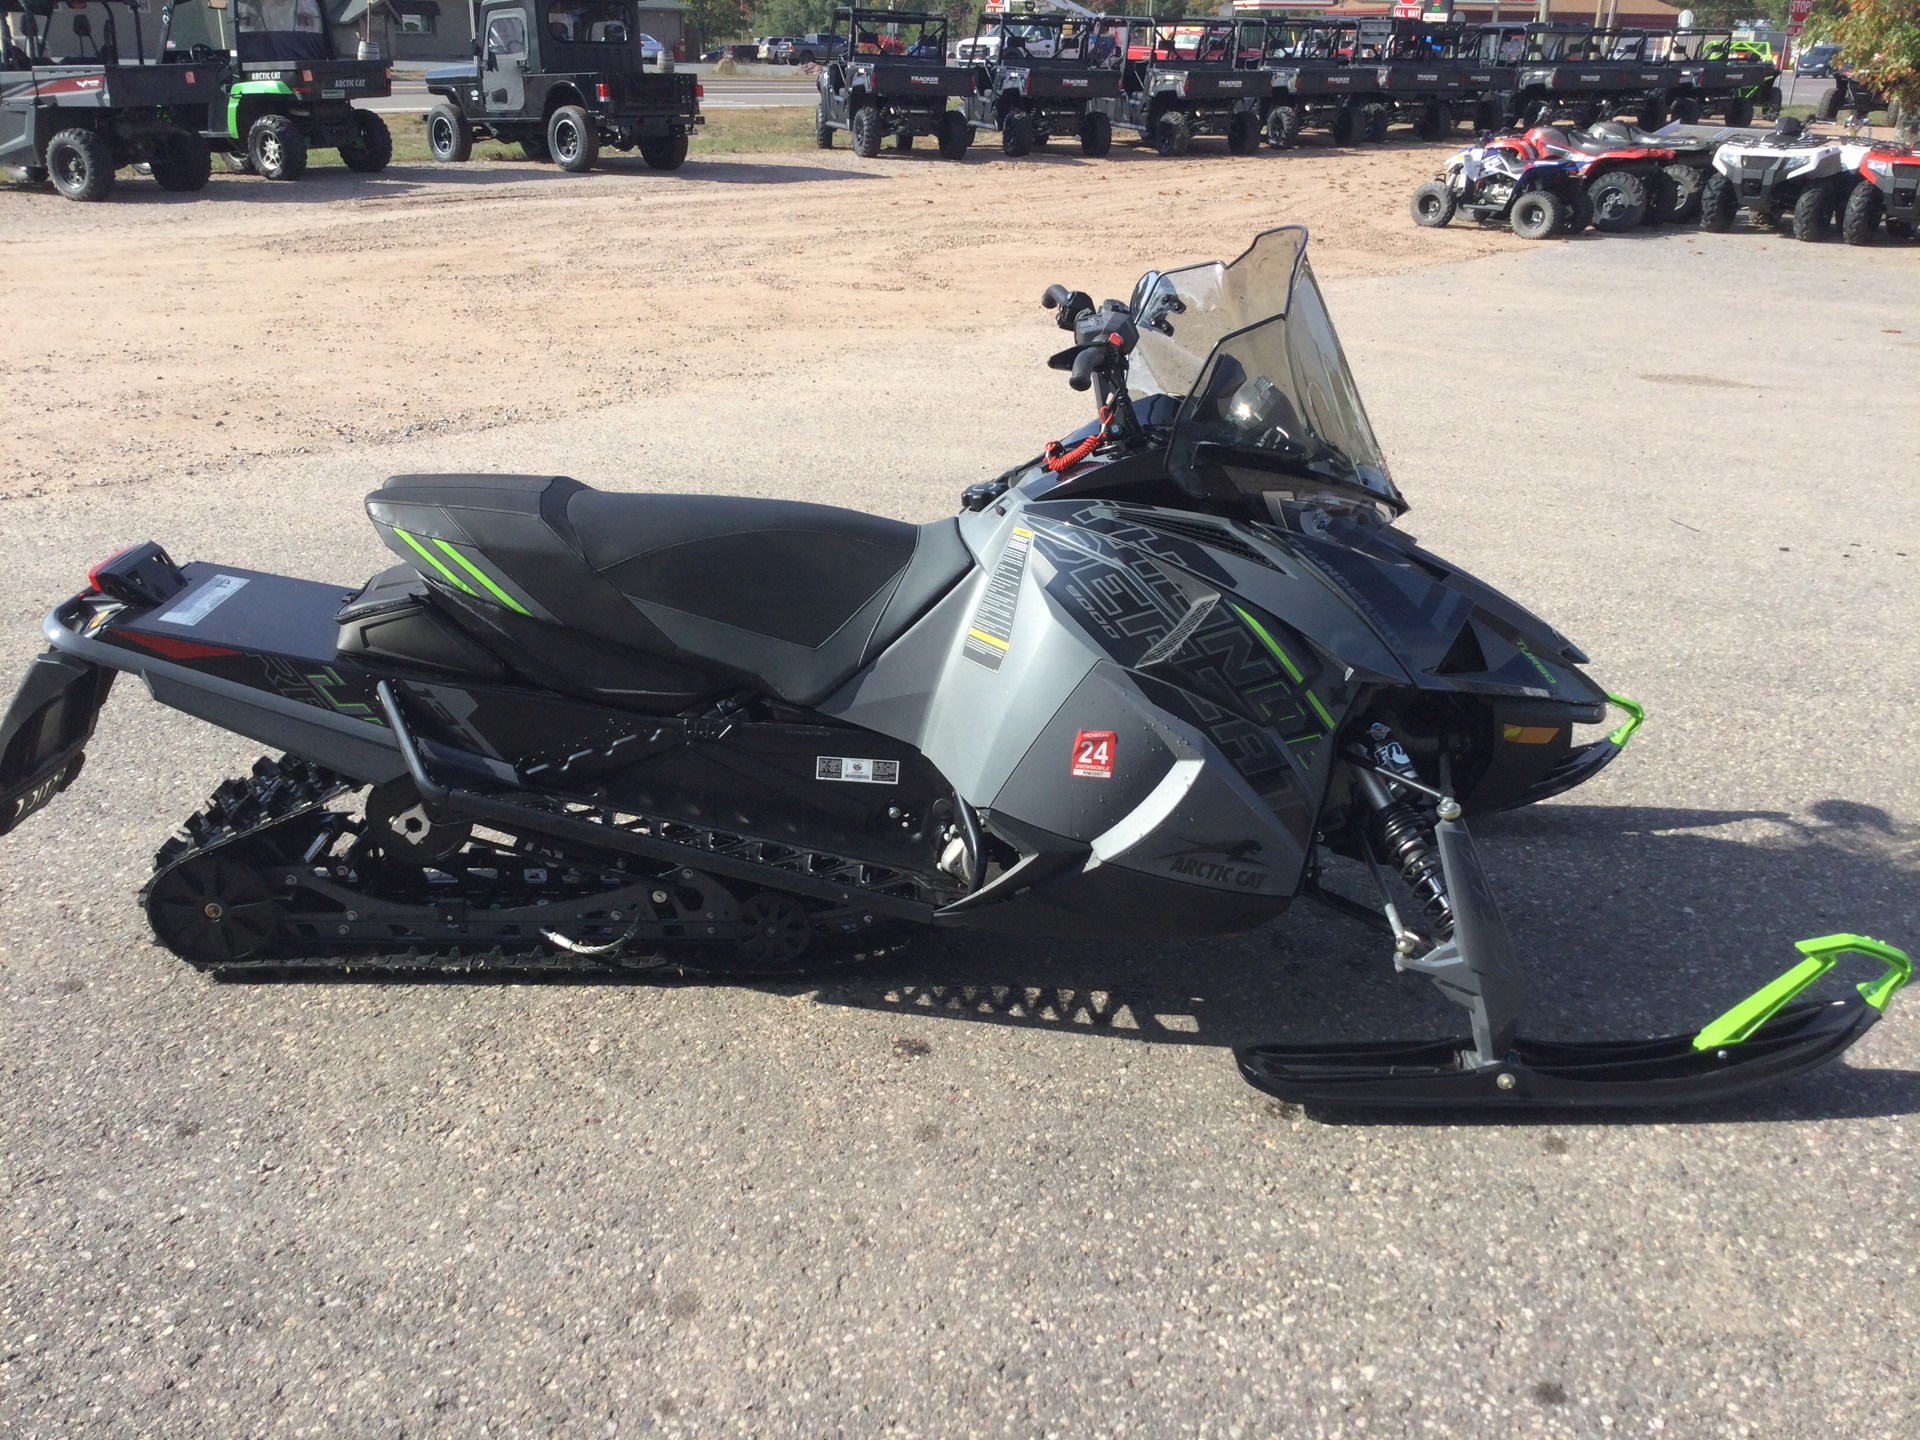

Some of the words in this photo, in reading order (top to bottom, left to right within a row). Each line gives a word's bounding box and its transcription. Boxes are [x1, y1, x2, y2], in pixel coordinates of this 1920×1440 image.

[1792, 1, 1811, 13] STOP
[251, 72, 270, 80] ARCTIC
[270, 71, 281, 80] CAT
[334, 79, 355, 88] ARCTIC
[355, 79, 366, 88] CAT
[1065, 584, 1121, 639] 9000
[1516, 637, 1557, 684] TURBO
[1078, 740, 1109, 765] 24
[1168, 857, 1235, 882] ARCTIC
[1234, 870, 1268, 889] CAT
